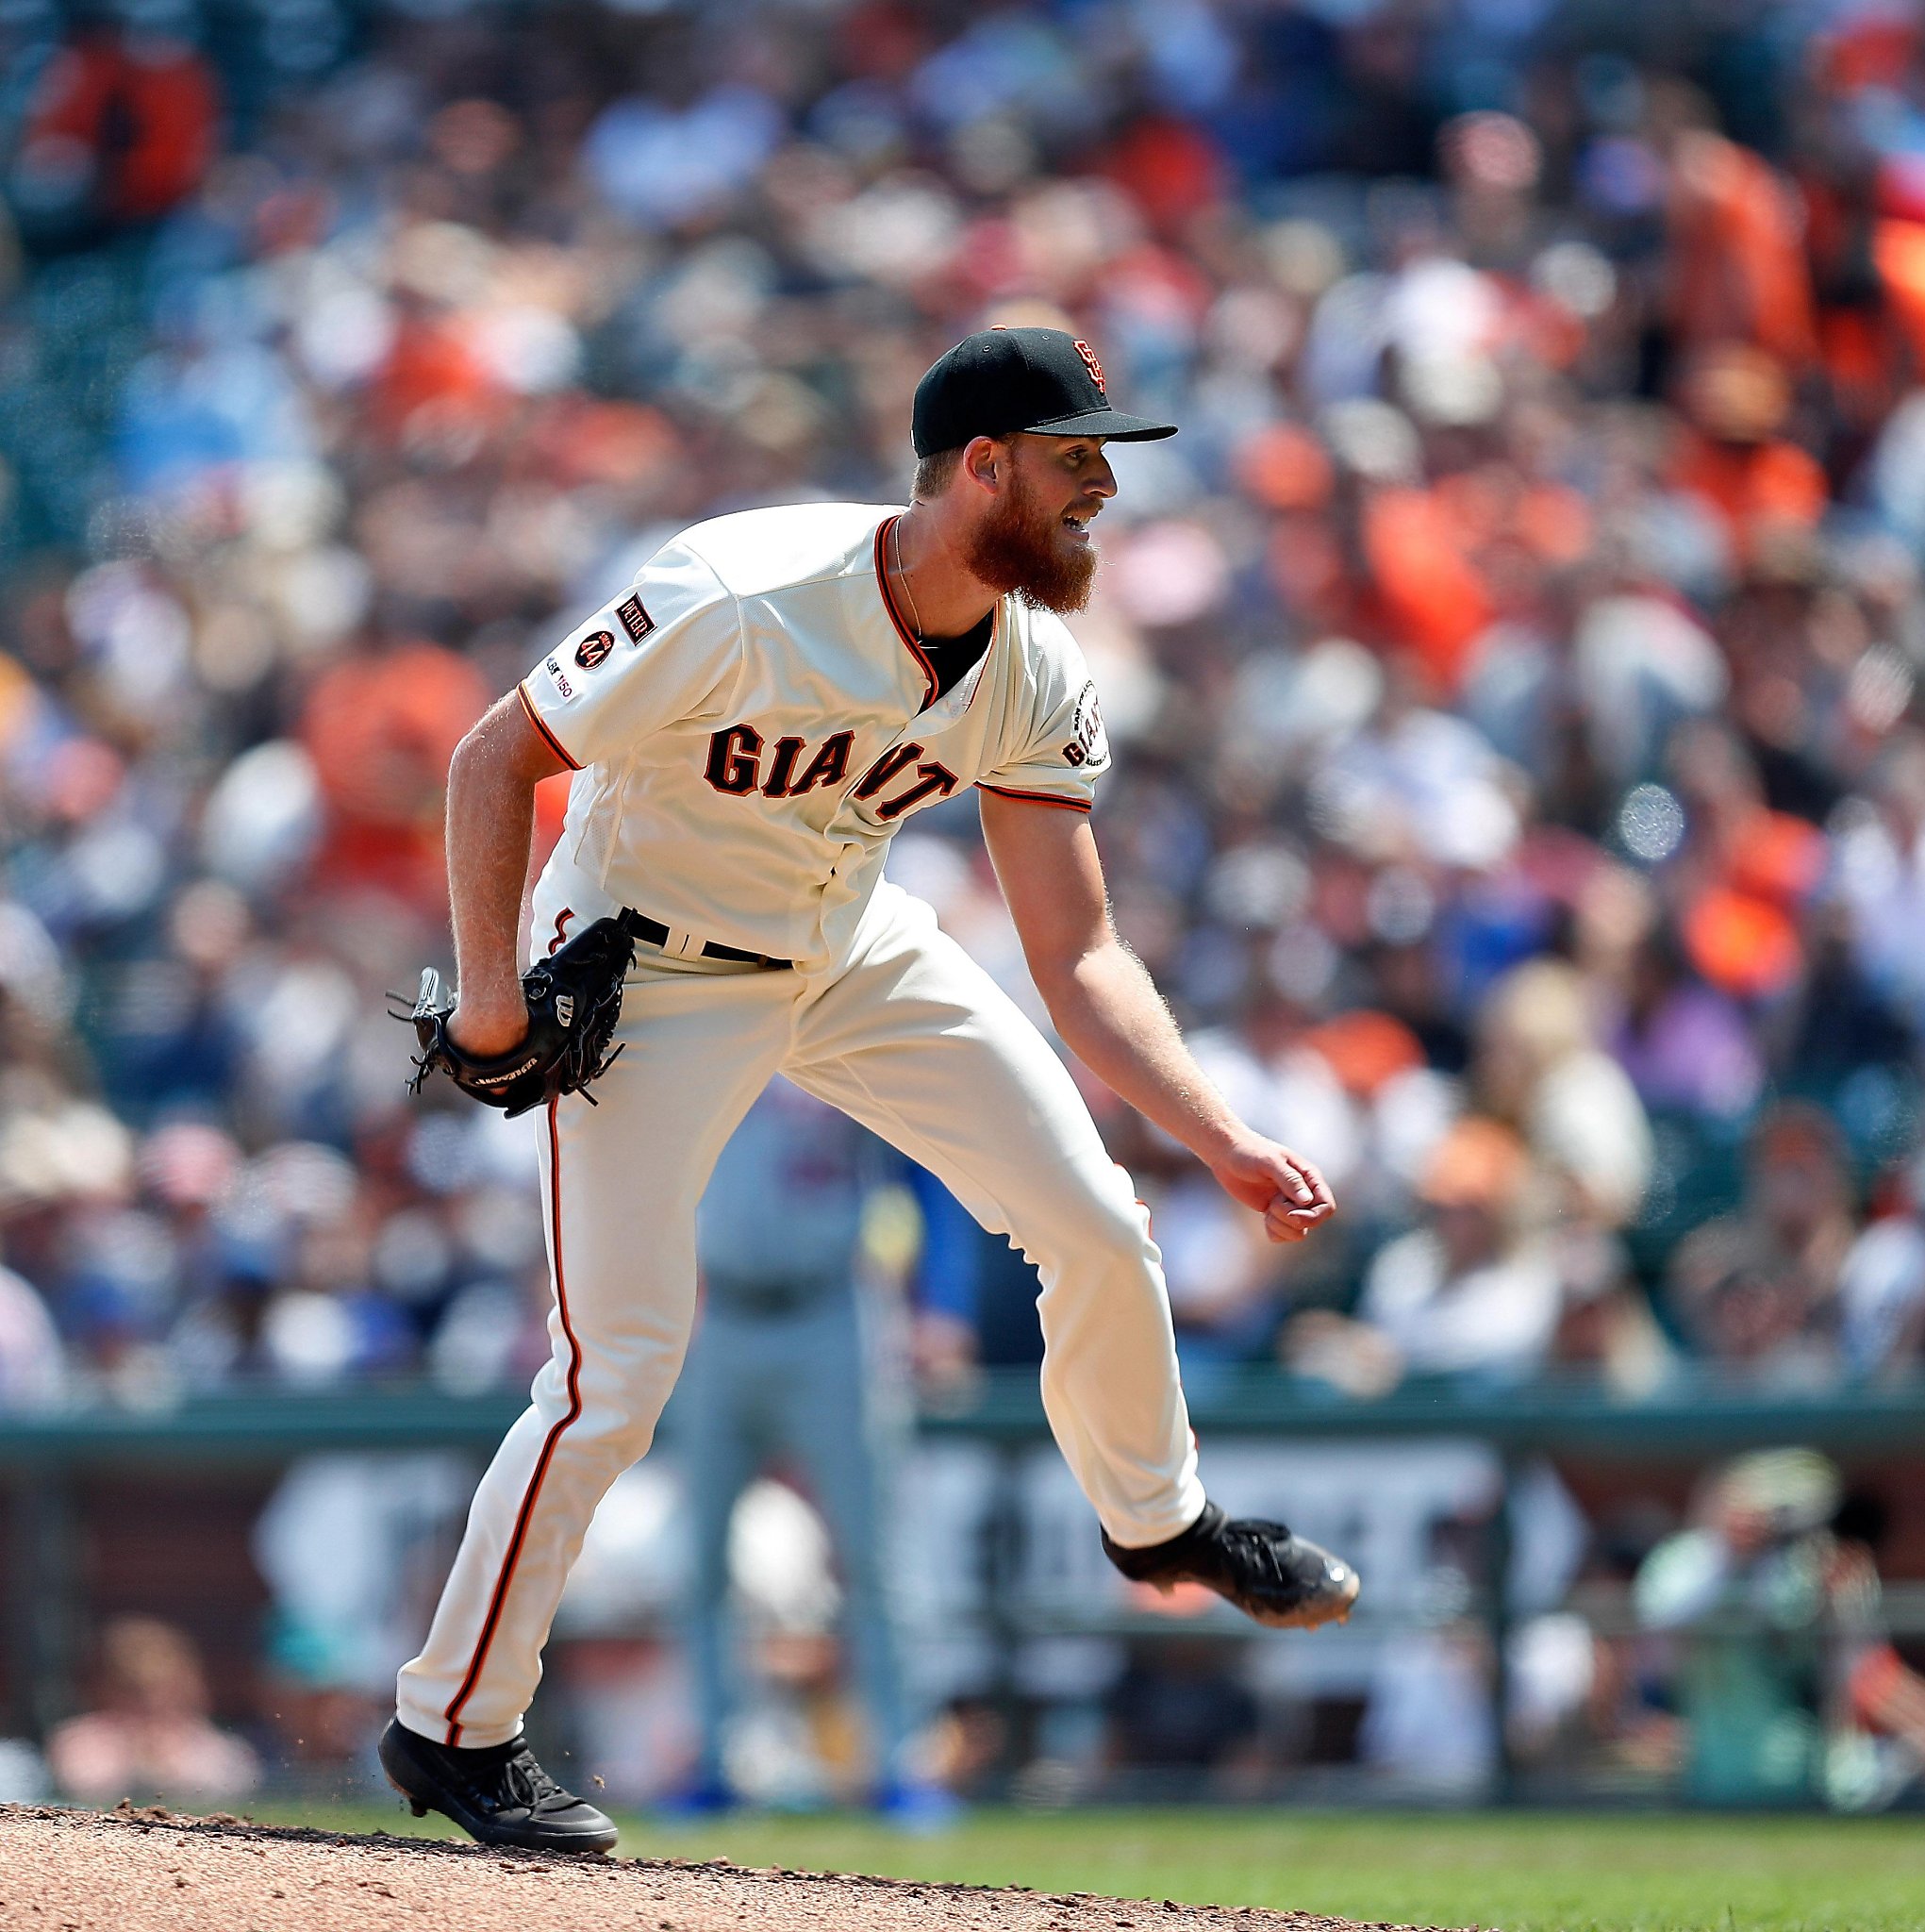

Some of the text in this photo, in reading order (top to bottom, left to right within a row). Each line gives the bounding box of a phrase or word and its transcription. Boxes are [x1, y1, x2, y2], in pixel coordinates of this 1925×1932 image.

[621, 600, 648, 637] PETER
[581, 640, 605, 666] 44
[703, 723, 960, 822] GIANT
